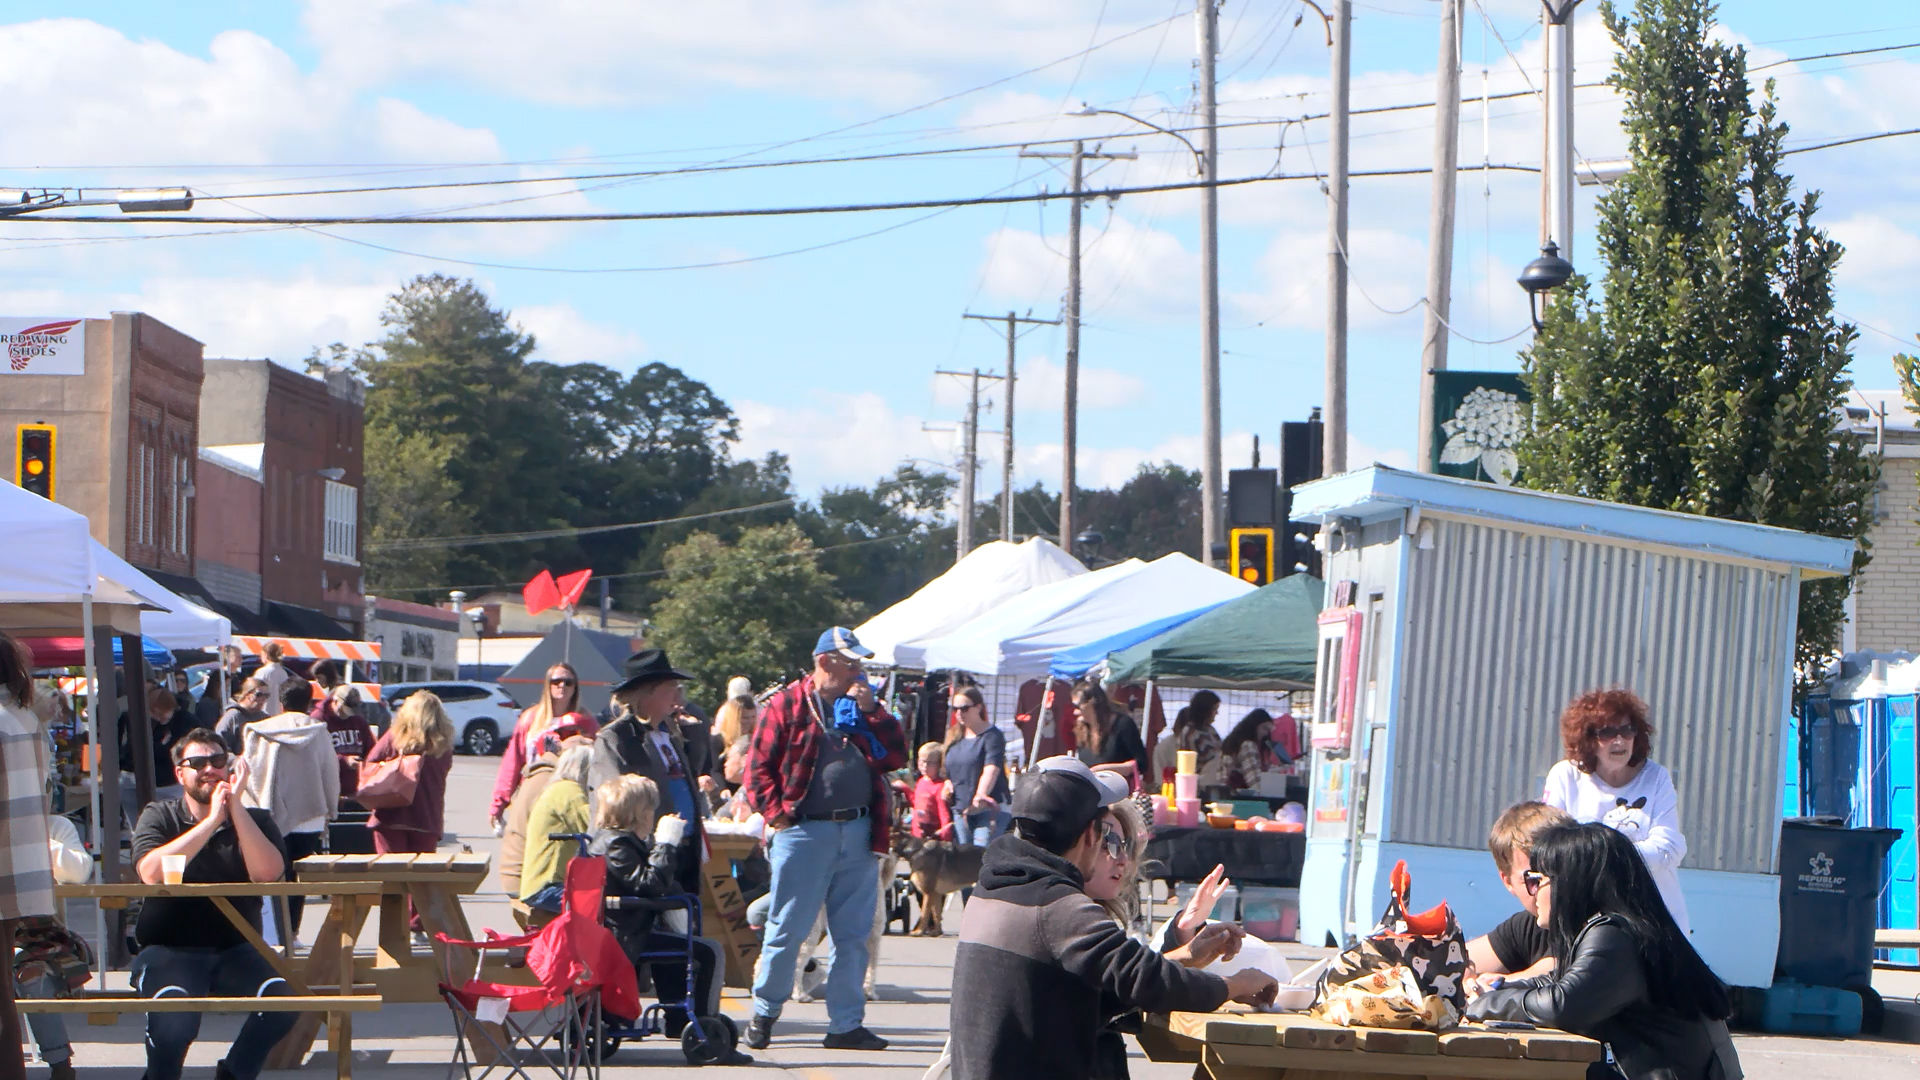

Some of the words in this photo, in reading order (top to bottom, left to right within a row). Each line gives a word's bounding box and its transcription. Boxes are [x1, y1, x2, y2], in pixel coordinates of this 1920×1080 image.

[1, 334, 26, 343] RED
[31, 335, 68, 344] WING
[12, 347, 57, 356] SHOES
